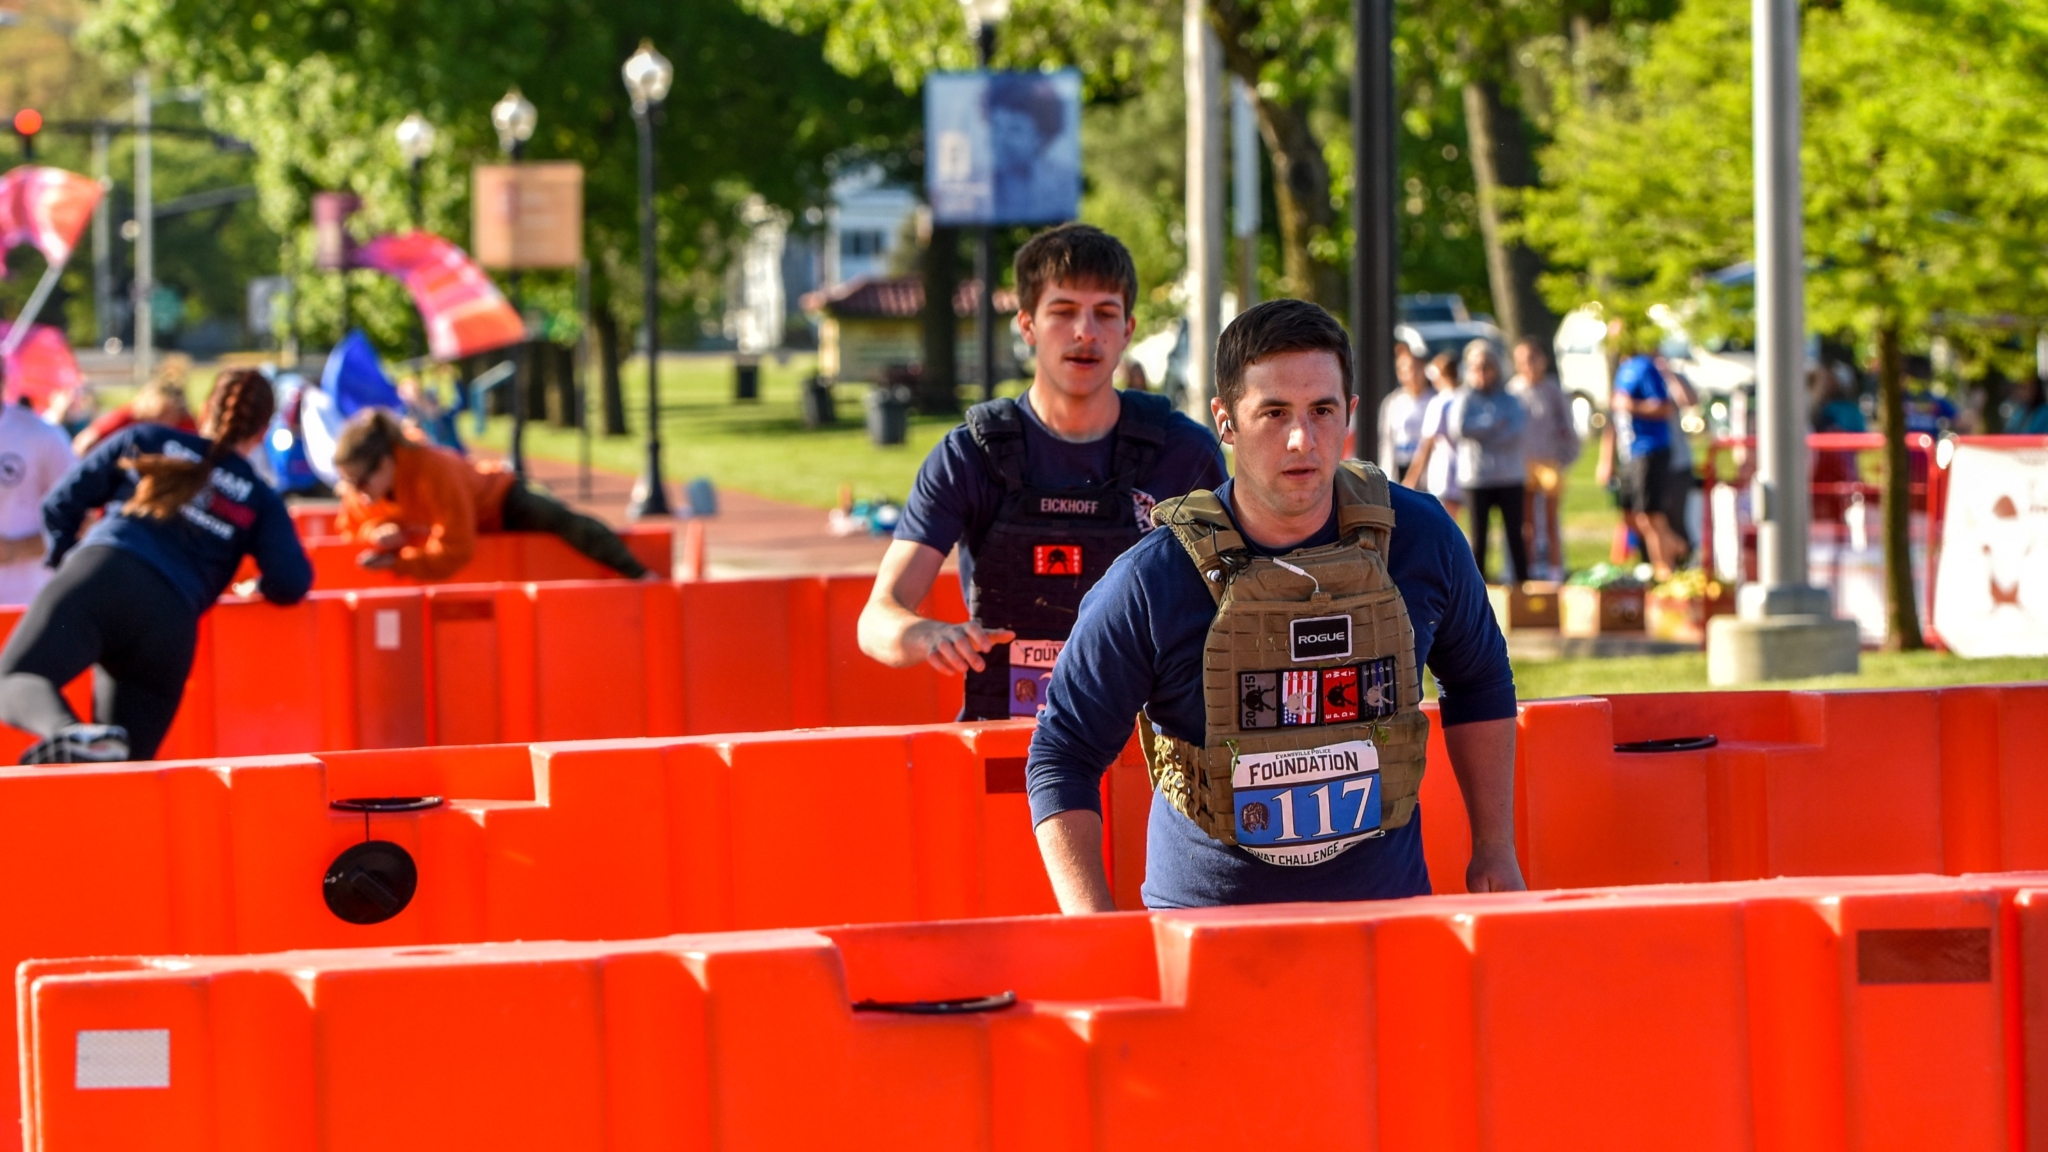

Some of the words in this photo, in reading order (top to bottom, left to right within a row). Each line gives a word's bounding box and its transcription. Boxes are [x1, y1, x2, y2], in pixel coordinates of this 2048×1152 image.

[1040, 498, 1099, 514] EICKHOFF
[1297, 631, 1346, 645] ROGUE
[1325, 670, 1356, 678] SWAT
[1325, 711, 1356, 720] EPDF
[1249, 750, 1359, 785] FOUNDATION
[1271, 776, 1373, 842] 117
[1278, 841, 1340, 866] CHALLENGE
